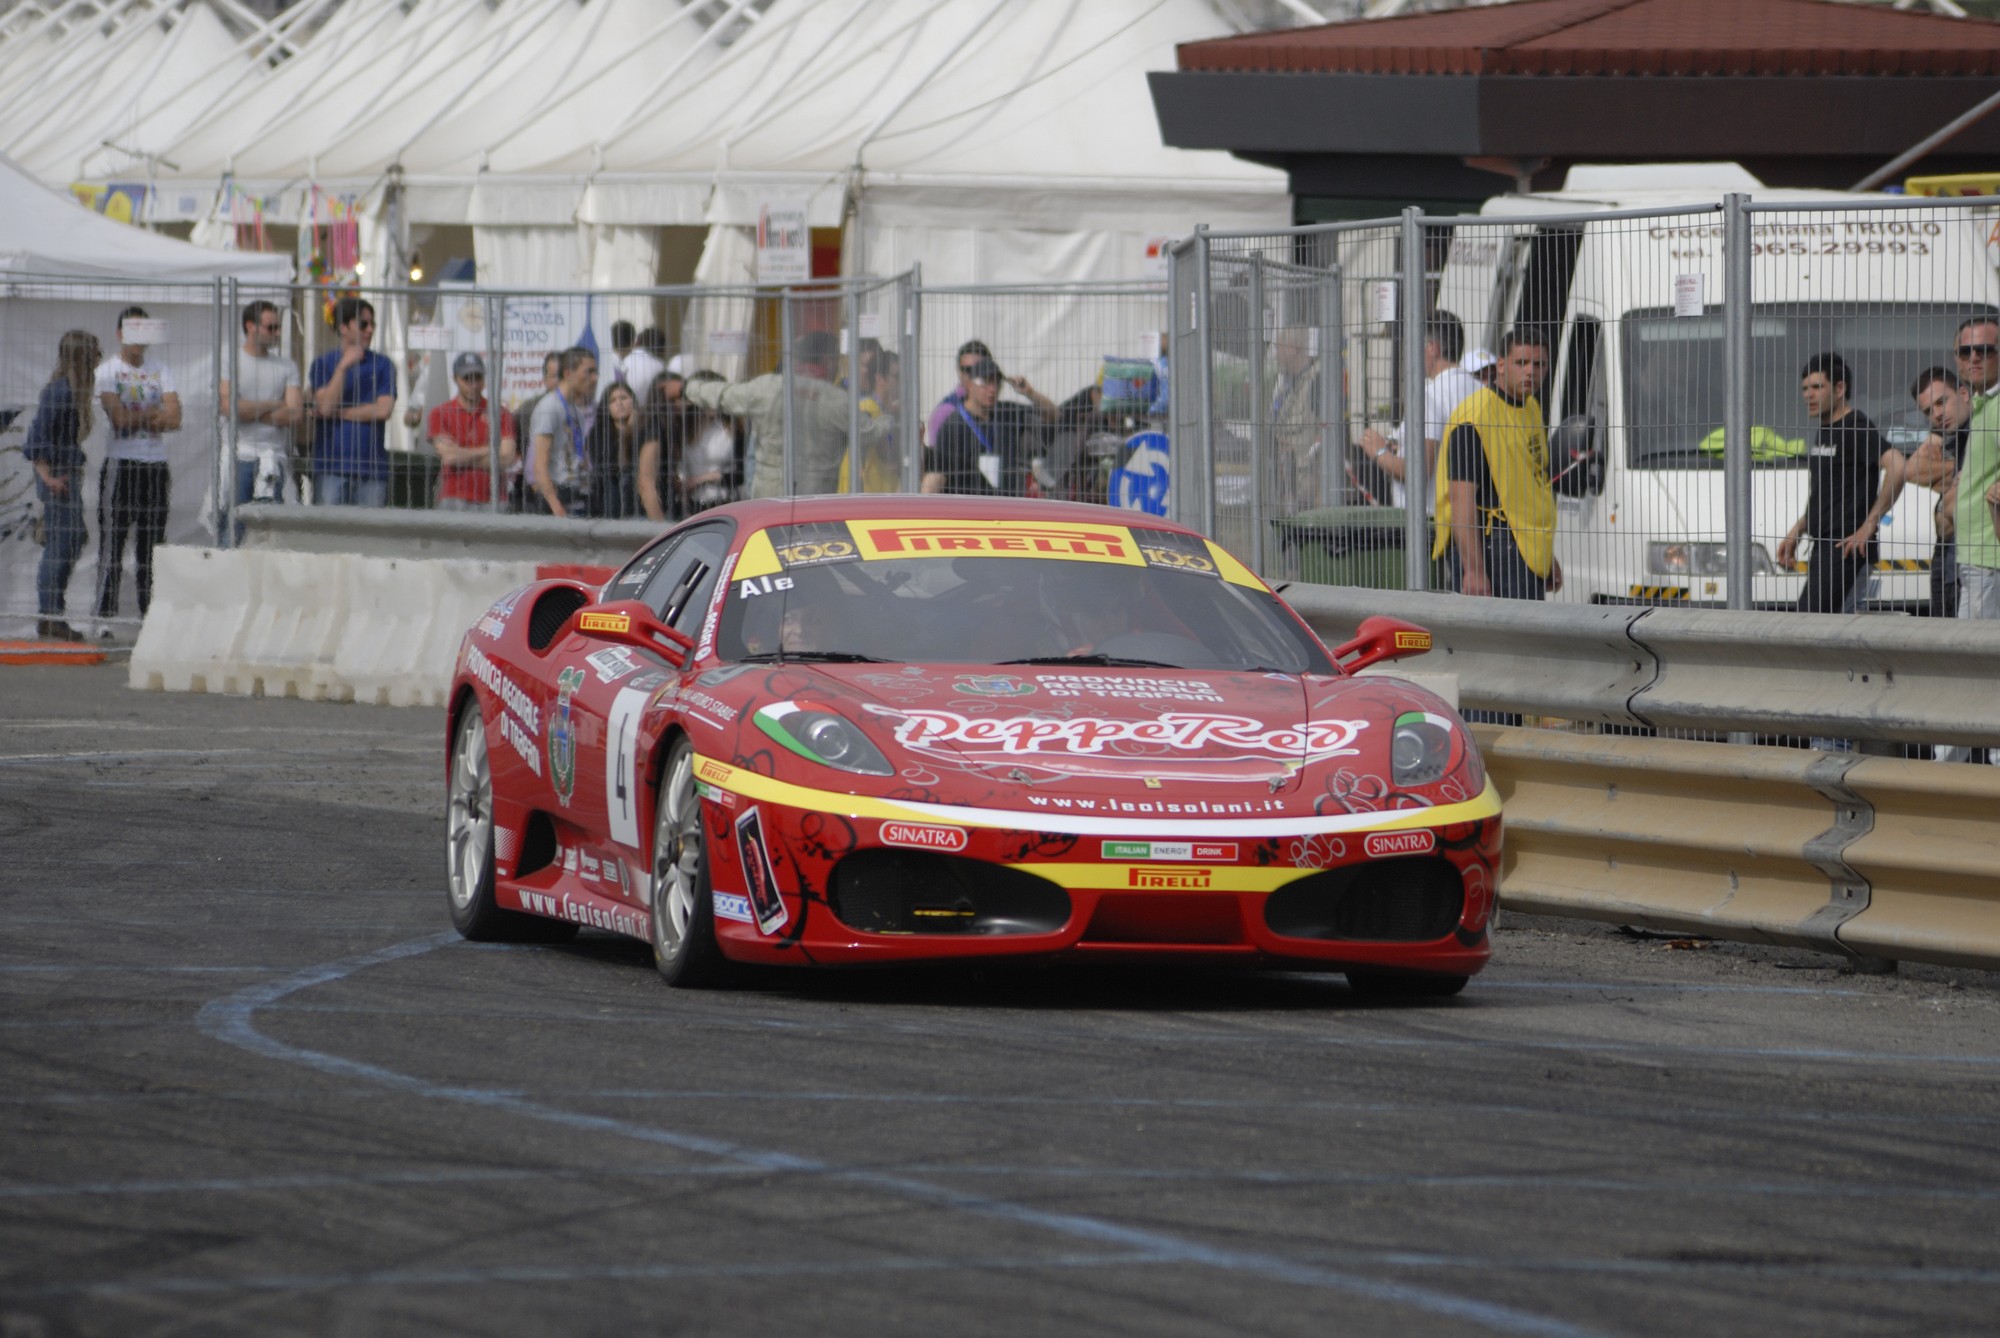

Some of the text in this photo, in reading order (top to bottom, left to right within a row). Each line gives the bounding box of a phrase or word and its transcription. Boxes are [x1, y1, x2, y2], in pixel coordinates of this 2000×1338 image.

[1650, 221, 1942, 240] Croce aliana TRIOLO
[1671, 241, 1930, 259] tel. 965.29993
[778, 541, 853, 562] 100
[867, 527, 1127, 558] PIRELLI
[1142, 549, 1214, 571] 100
[740, 576, 795, 599] Ale
[582, 614, 627, 630] PIRELLI
[1398, 634, 1430, 647] PIRELLI
[1035, 675, 1211, 688] PROVINCIA
[1042, 683, 1217, 696] REGIONALE
[1050, 689, 1225, 703] DI TRAPANI
[700, 760, 733, 782] PIRELLI
[1027, 796, 1285, 814] www.leoisolani.it
[888, 826, 958, 846] SINATRA
[1372, 834, 1429, 853] SINATRA
[1114, 845, 1222, 856] ITALIAN ENERGY DRINK
[1128, 868, 1212, 887] PIRELLI
[518, 889, 650, 939] www.leoisolani.it
